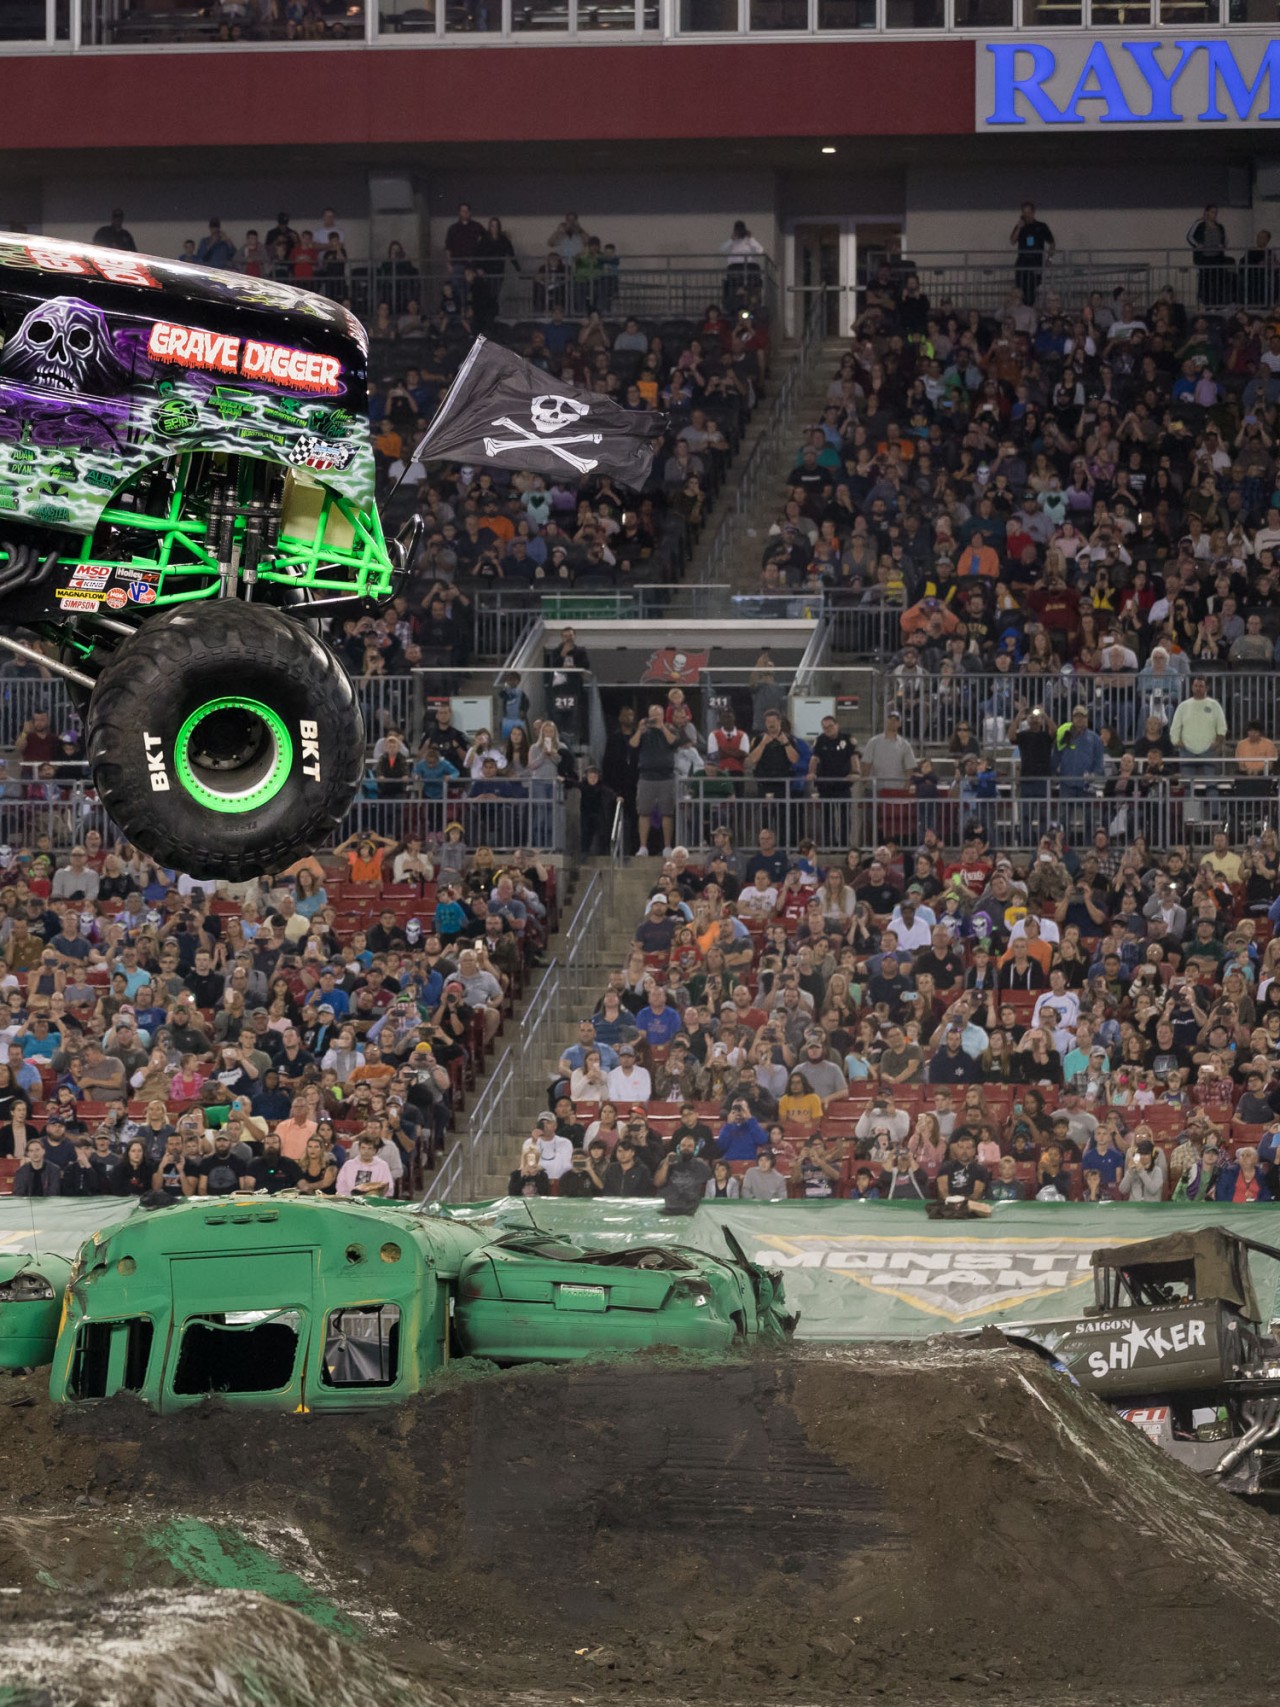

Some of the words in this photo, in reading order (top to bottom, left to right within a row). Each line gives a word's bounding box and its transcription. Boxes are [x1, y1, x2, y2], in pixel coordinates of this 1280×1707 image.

[149, 323, 240, 368] GRAVE
[244, 341, 340, 386] DIGGER
[163, 416, 189, 426] SPIN
[76, 565, 110, 577] MSD
[116, 567, 143, 580] Holley
[57, 589, 105, 600] MAGNAFLOW
[130, 581, 150, 602] VP
[63, 599, 96, 610] SIMPSON
[300, 720, 321, 782] BKT
[144, 732, 170, 792] BKT
[871, 1269, 1069, 1287] JAM
[1075, 1319, 1133, 1334] SAIGON
